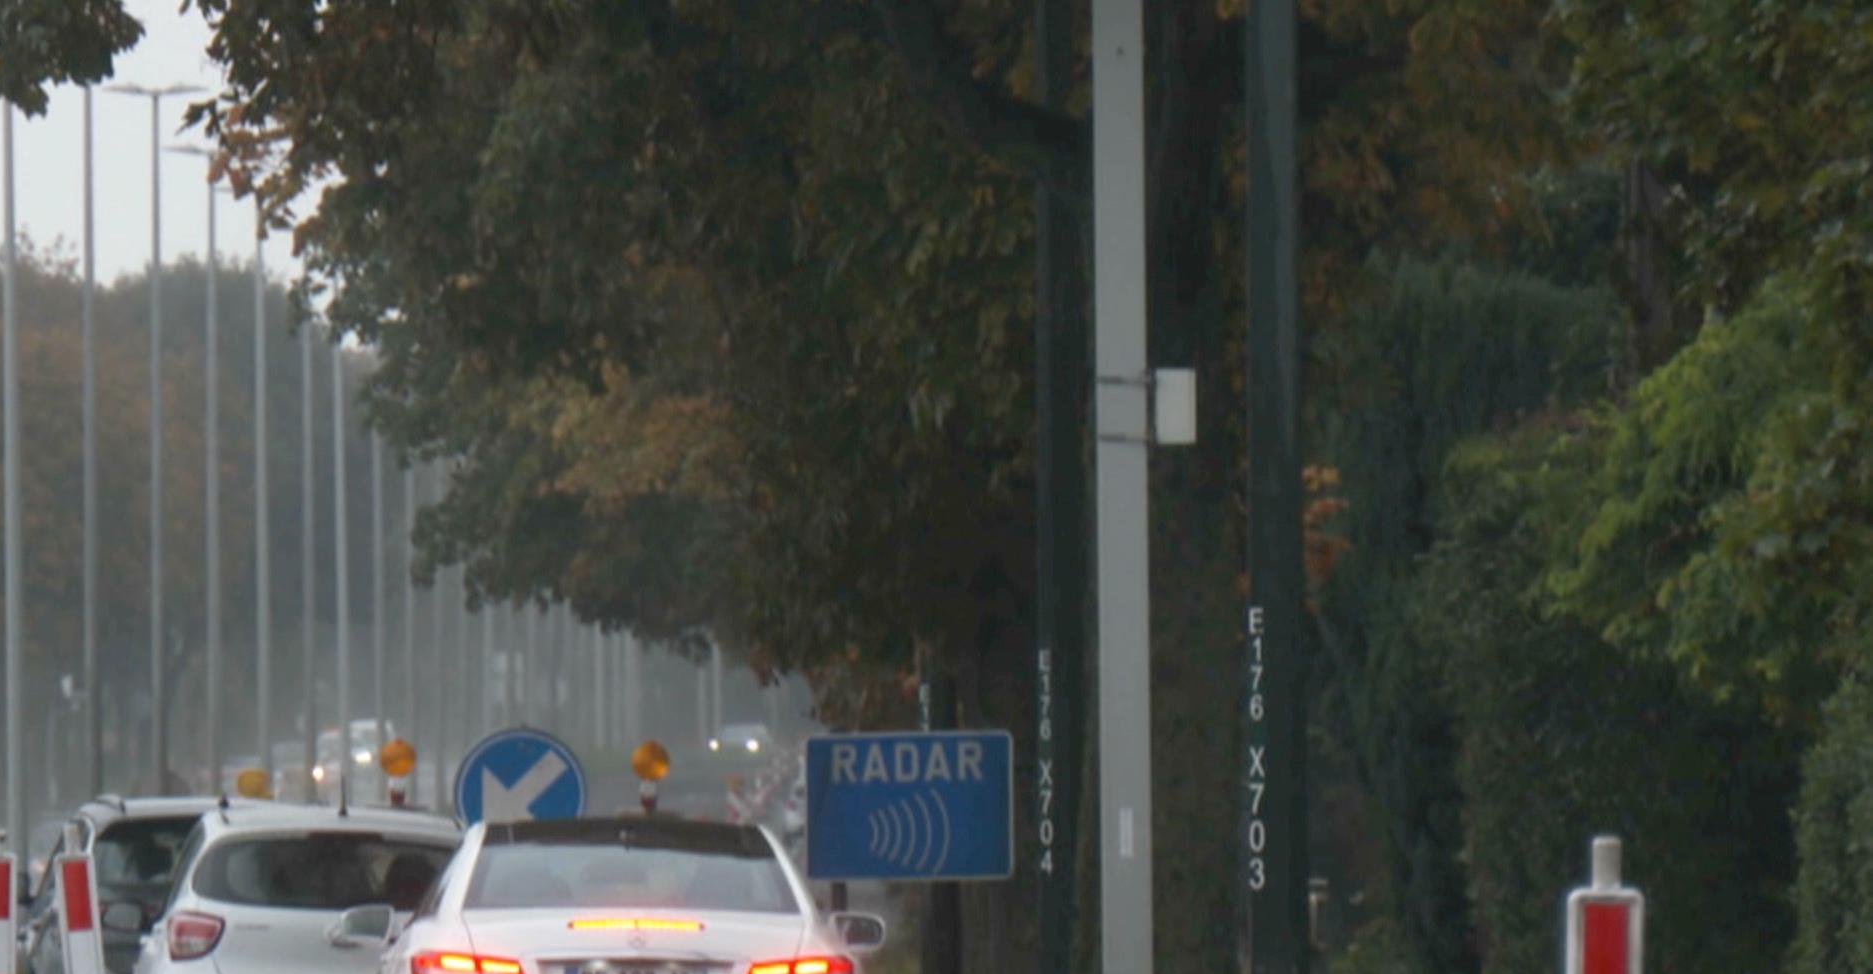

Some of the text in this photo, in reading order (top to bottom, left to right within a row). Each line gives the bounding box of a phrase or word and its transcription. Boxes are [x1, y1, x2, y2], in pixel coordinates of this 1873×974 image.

[831, 741, 984, 783] RADAR
[1038, 648, 1054, 876] E176 X704
[1247, 606, 1266, 890] E176 X703
